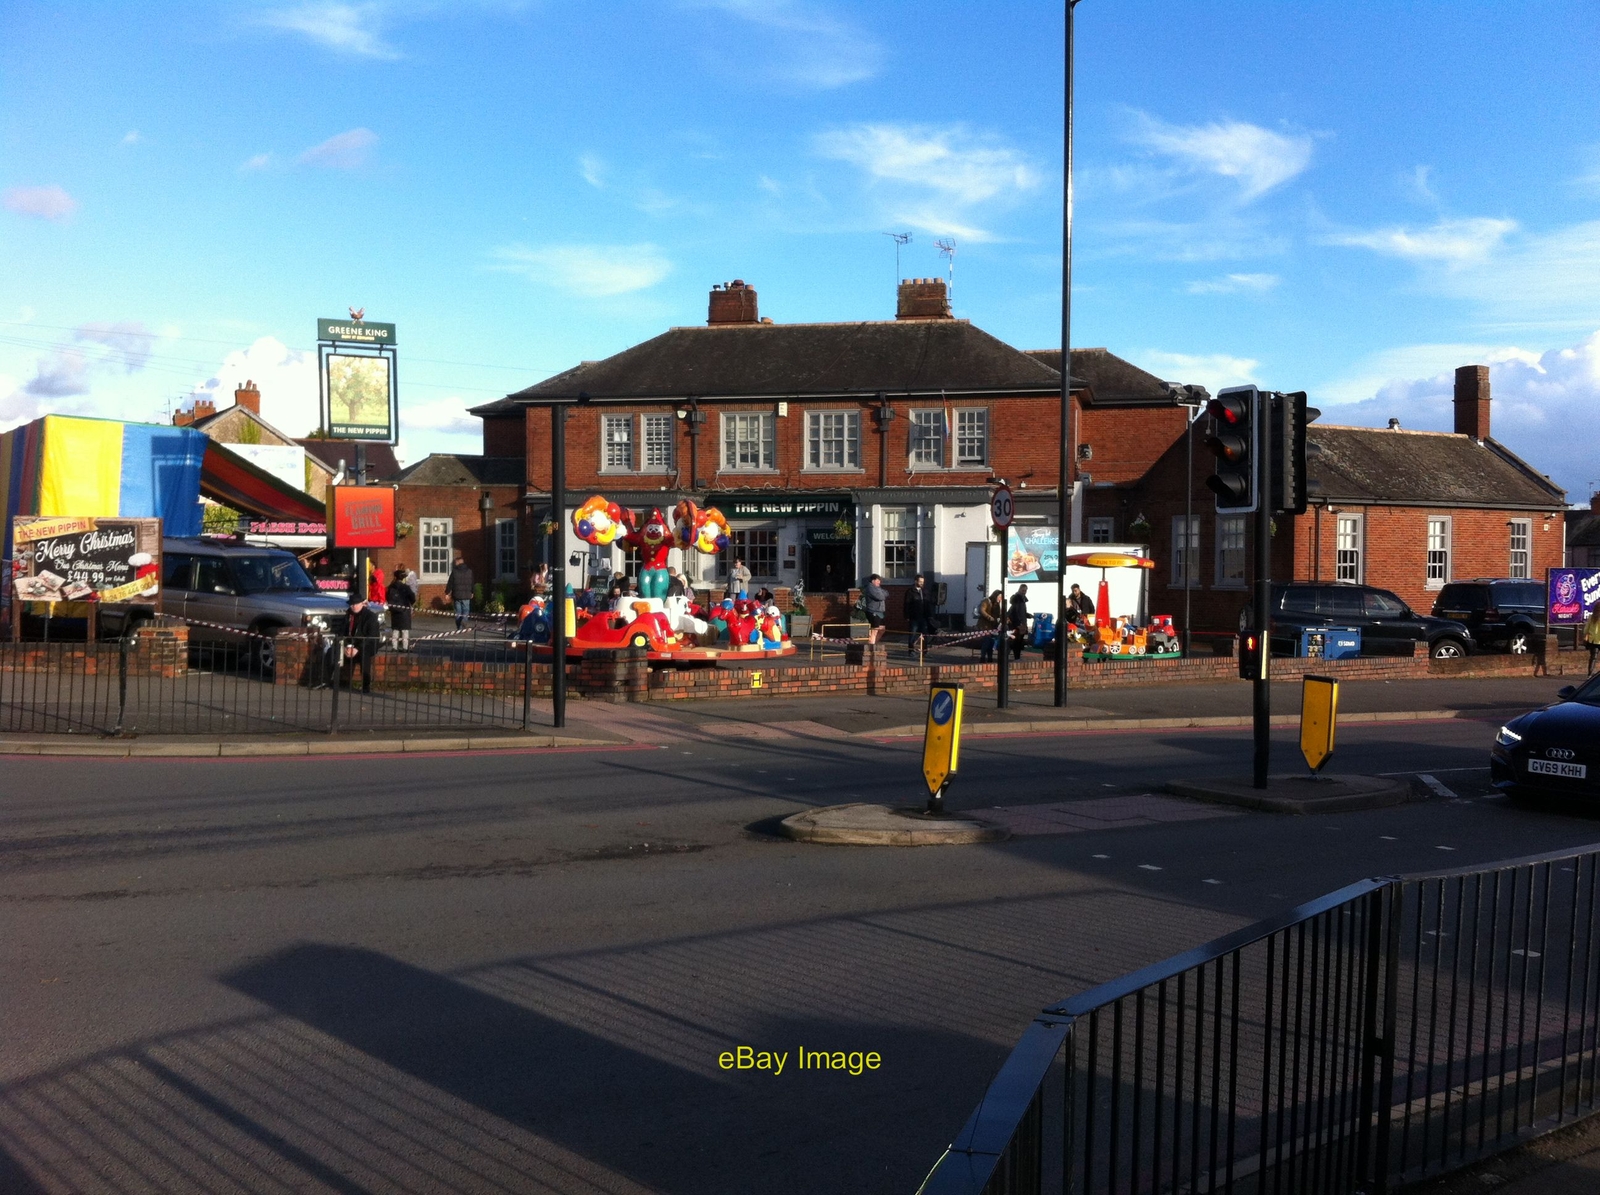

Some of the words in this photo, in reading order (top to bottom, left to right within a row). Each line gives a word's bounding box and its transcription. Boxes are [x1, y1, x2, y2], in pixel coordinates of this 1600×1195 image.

[328, 326, 363, 336] GREENE
[365, 329, 388, 338] KING
[365, 428, 388, 436] PIPPIN
[734, 502, 759, 513] THE
[762, 502, 793, 513] NEW
[796, 502, 839, 512] PIPPIN
[994, 499, 1012, 518] 30
[351, 514, 382, 530] GRILL
[18, 530, 34, 540] THE
[36, 526, 56, 537] NEW
[58, 520, 87, 533] PIPPIN
[35, 540, 76, 563] Merry
[80, 530, 136, 555] Christmas
[72, 560, 104, 571] Christmas
[105, 560, 130, 572] Menu
[67, 570, 105, 583] £44.99
[1581, 572, 1600, 592] Ever
[1552, 603, 1580, 614] Karaoke
[752, 674, 761, 686] H
[1532, 761, 1558, 774] GV69
[1561, 764, 1582, 777] KHH
